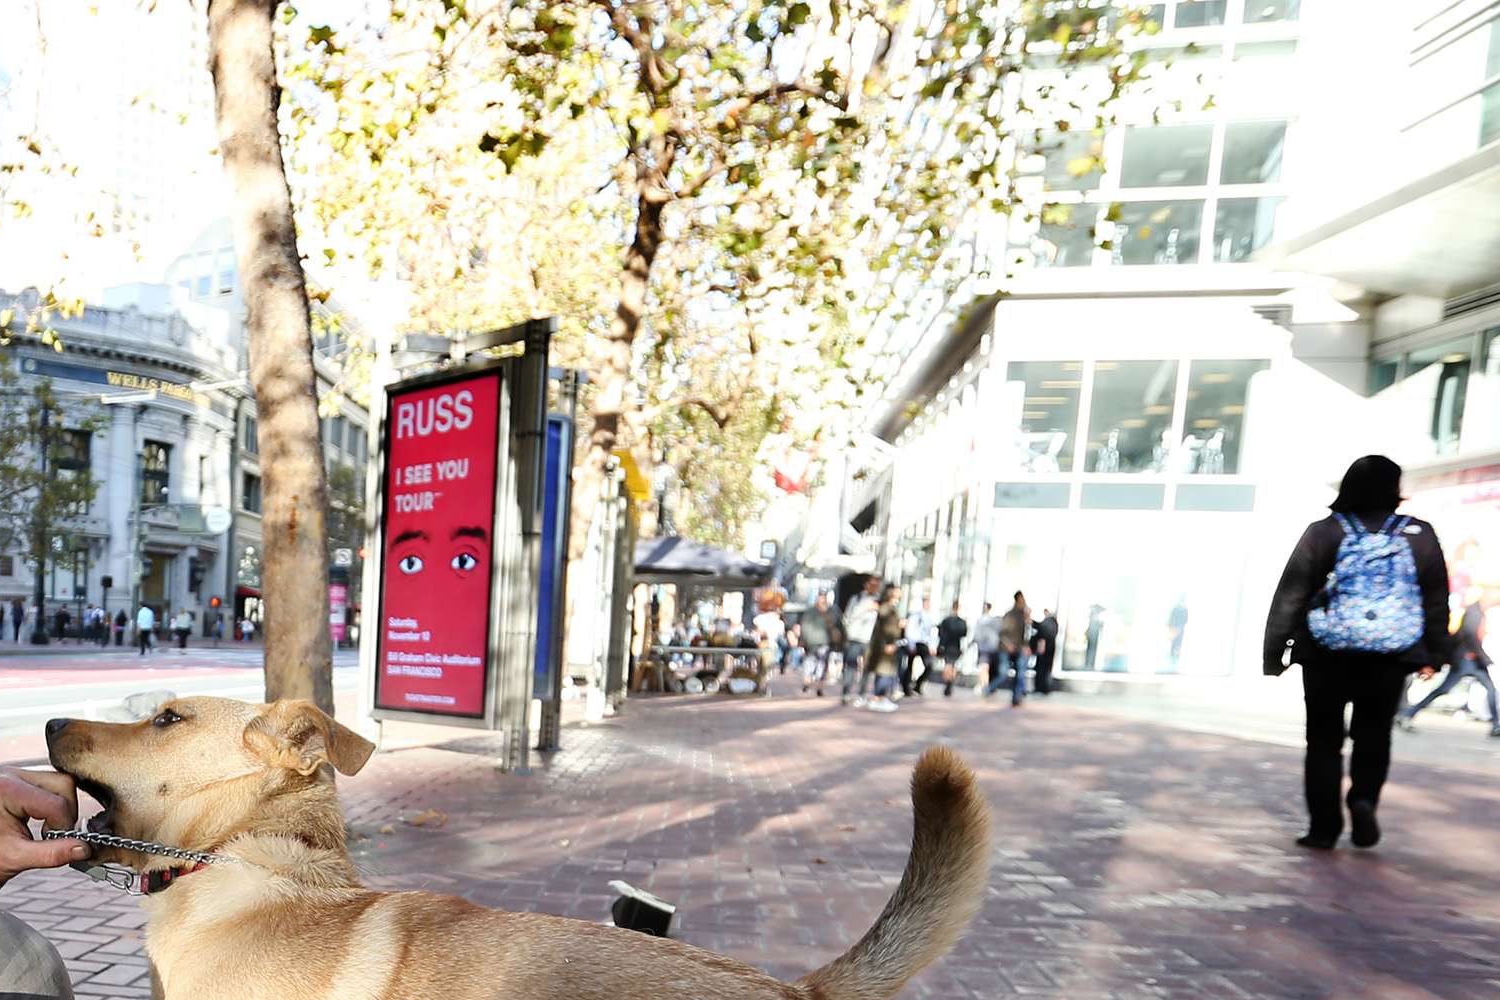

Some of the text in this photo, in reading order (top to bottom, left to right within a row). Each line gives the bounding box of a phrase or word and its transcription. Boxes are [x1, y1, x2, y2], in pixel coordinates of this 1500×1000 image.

[107, 371, 158, 390] WELLS
[396, 390, 474, 439] RUSS
[396, 458, 468, 486] I SEE YOU
